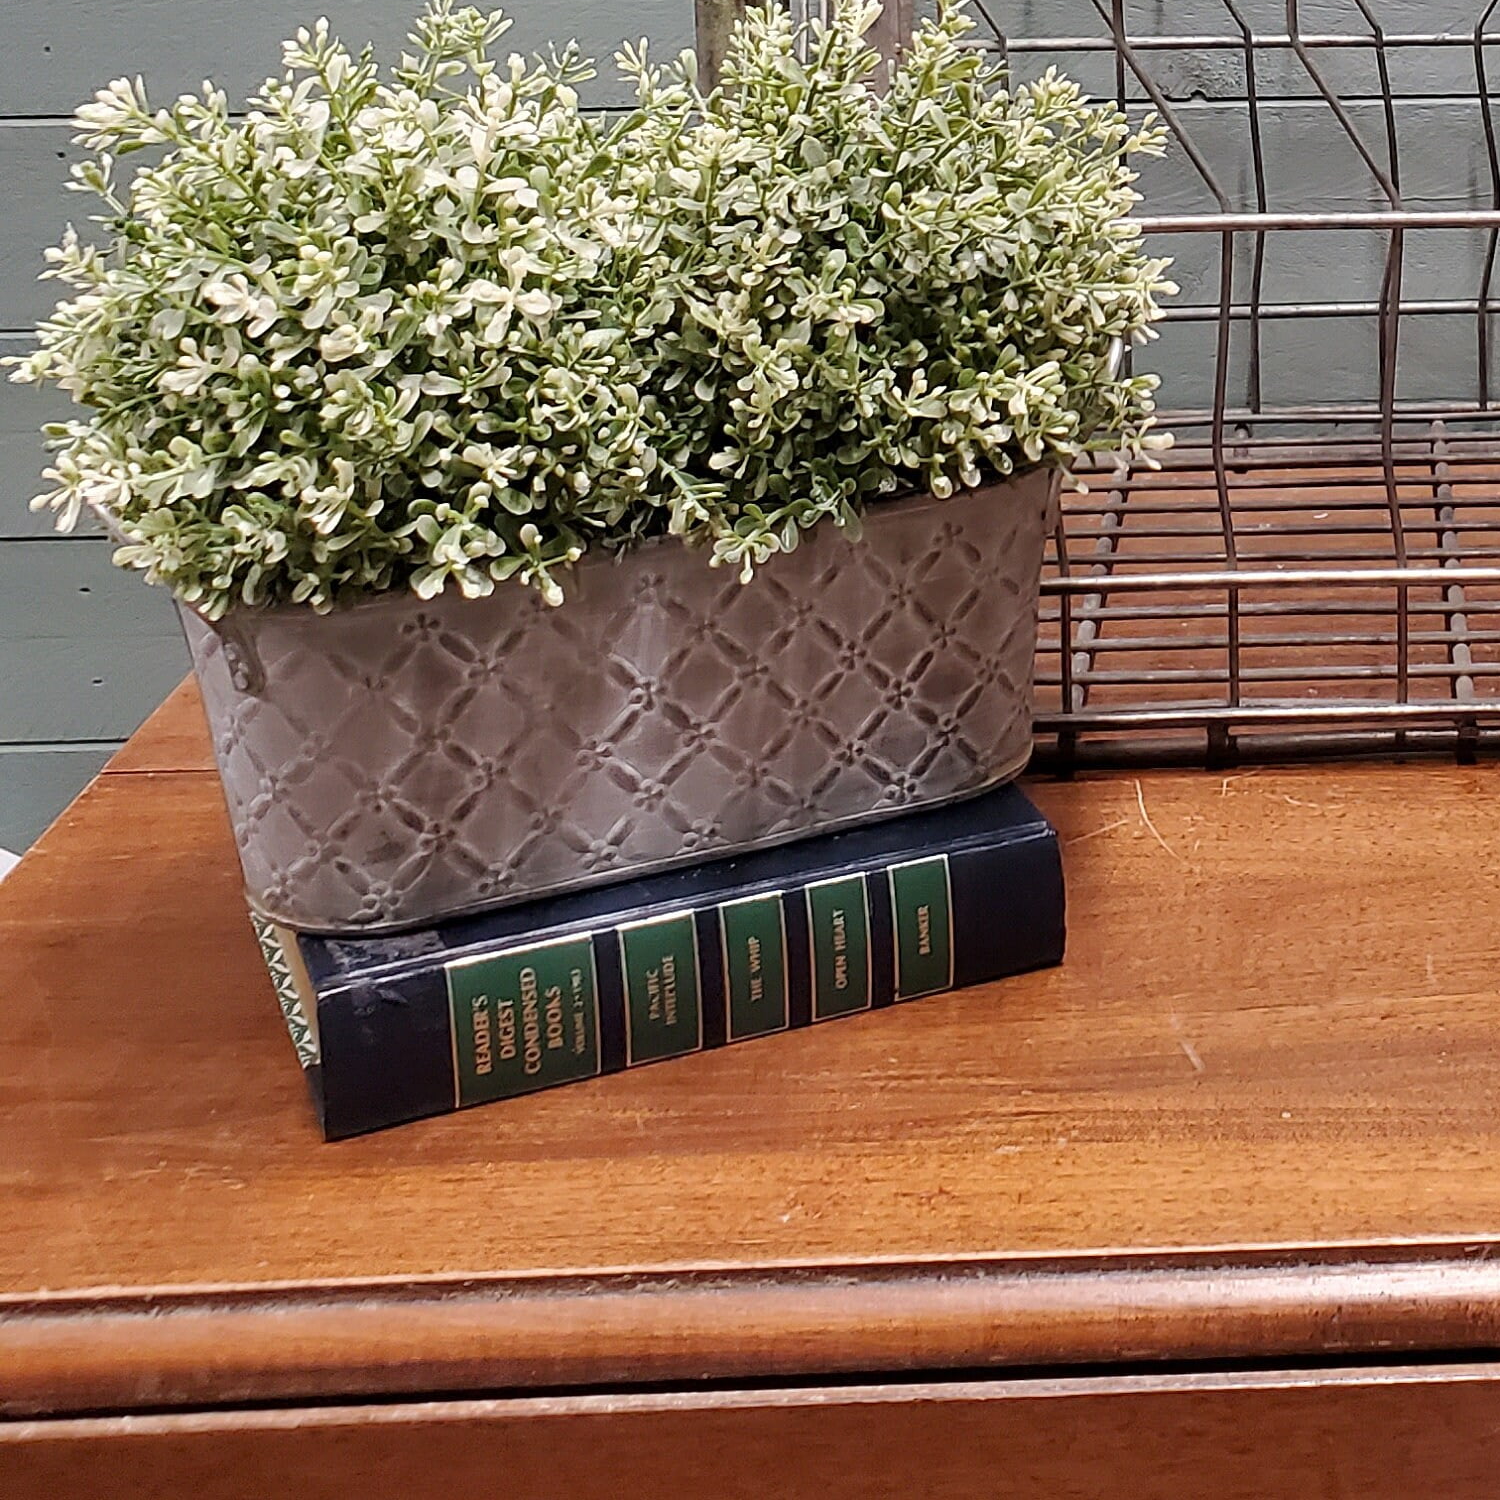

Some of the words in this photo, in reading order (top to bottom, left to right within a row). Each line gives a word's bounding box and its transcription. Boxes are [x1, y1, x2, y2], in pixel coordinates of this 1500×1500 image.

[747, 936, 762, 973] WHIP
[832, 908, 846, 952] HEART
[917, 904, 931, 956] BANKER
[646, 968, 660, 1020] PACIFIC
[662, 955, 678, 1025] INTERLUDE
[750, 974, 764, 1002] THE
[834, 954, 848, 990] OPEN
[472, 994, 492, 1075] READER'S
[498, 999, 516, 1059] DIGEST
[520, 967, 542, 1075] CONDENSED
[545, 985, 564, 1049] BOOKS
